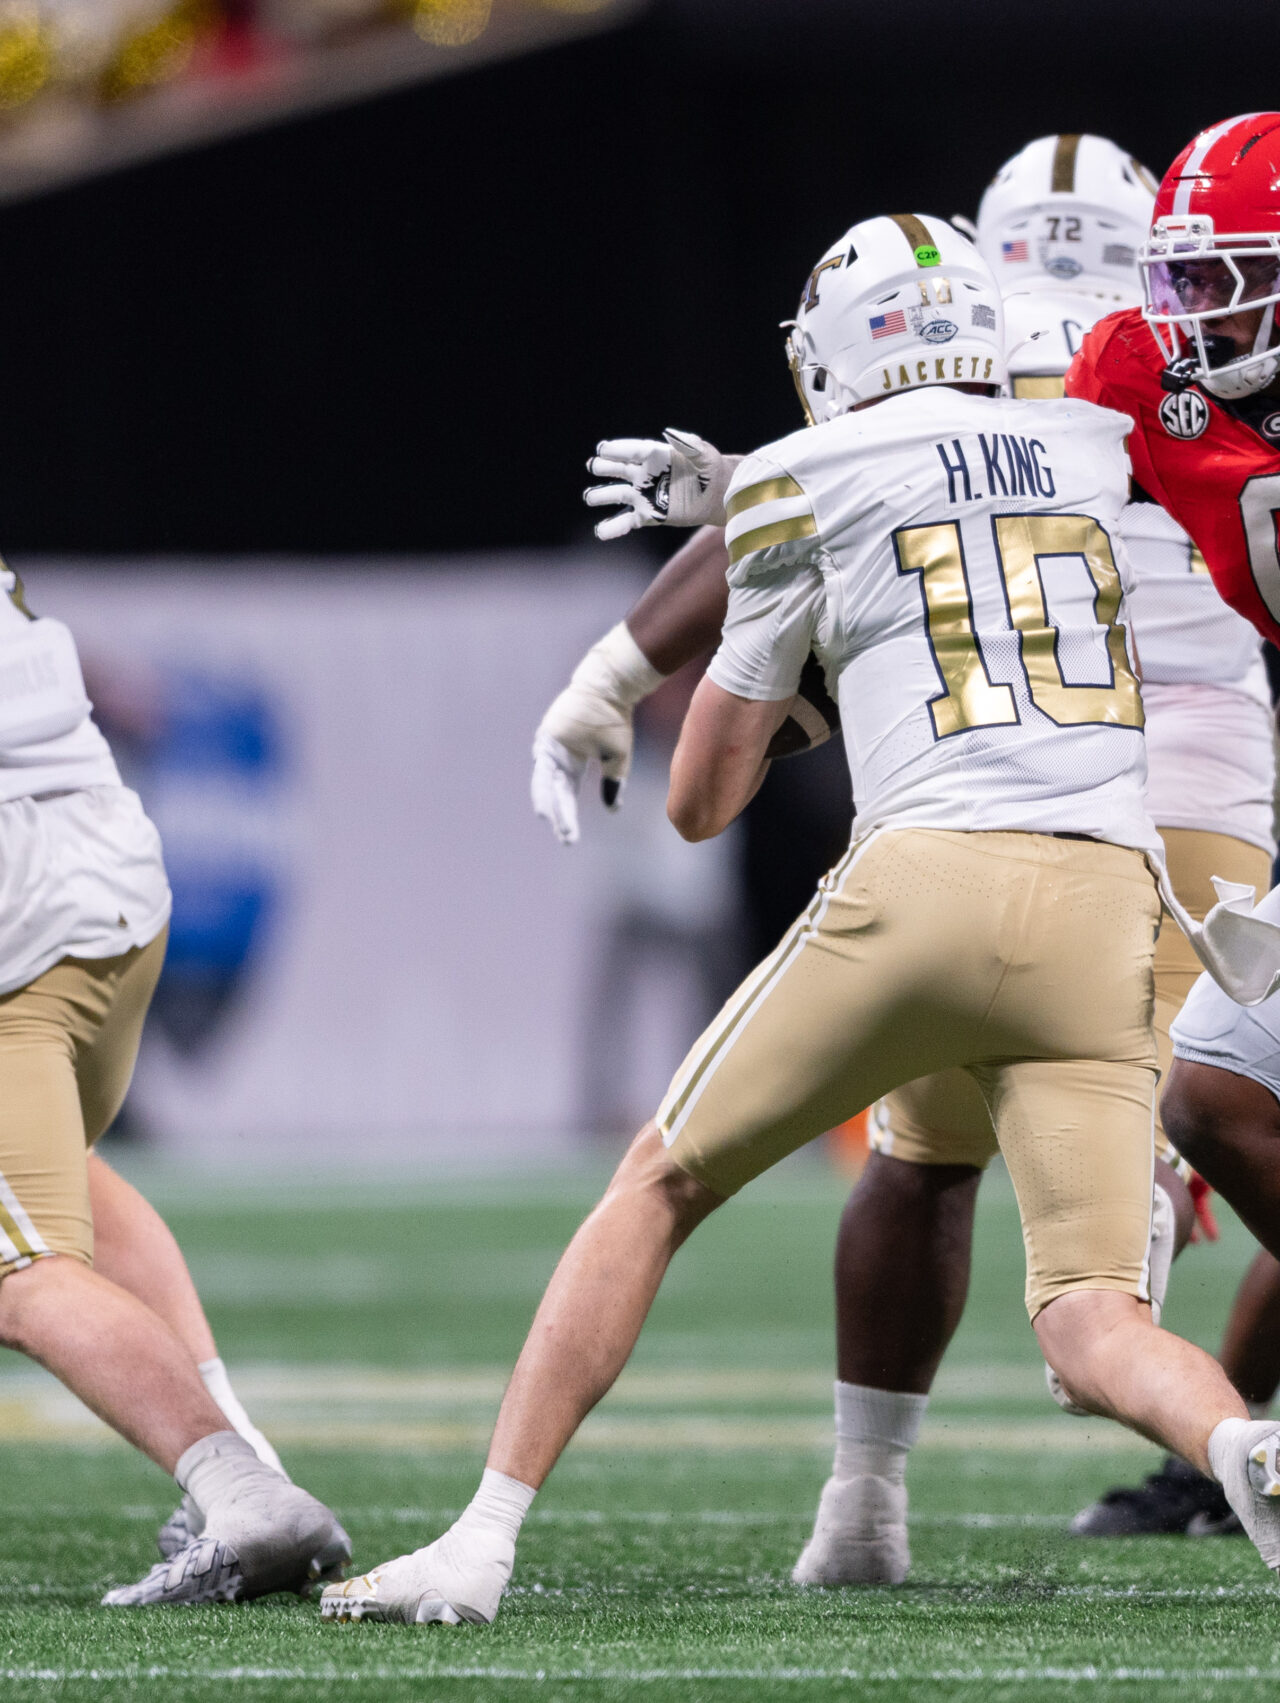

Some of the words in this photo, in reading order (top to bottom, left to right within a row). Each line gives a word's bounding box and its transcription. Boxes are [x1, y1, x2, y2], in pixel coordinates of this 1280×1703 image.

[1046, 216, 1082, 242] 72
[917, 250, 938, 261] C2P
[917, 277, 953, 307] 10
[927, 323, 953, 336] ACC
[883, 356, 993, 390] JACKETS
[1163, 391, 1204, 437] SEC
[936, 433, 1056, 503] H.KING
[891, 512, 1146, 742] 10
